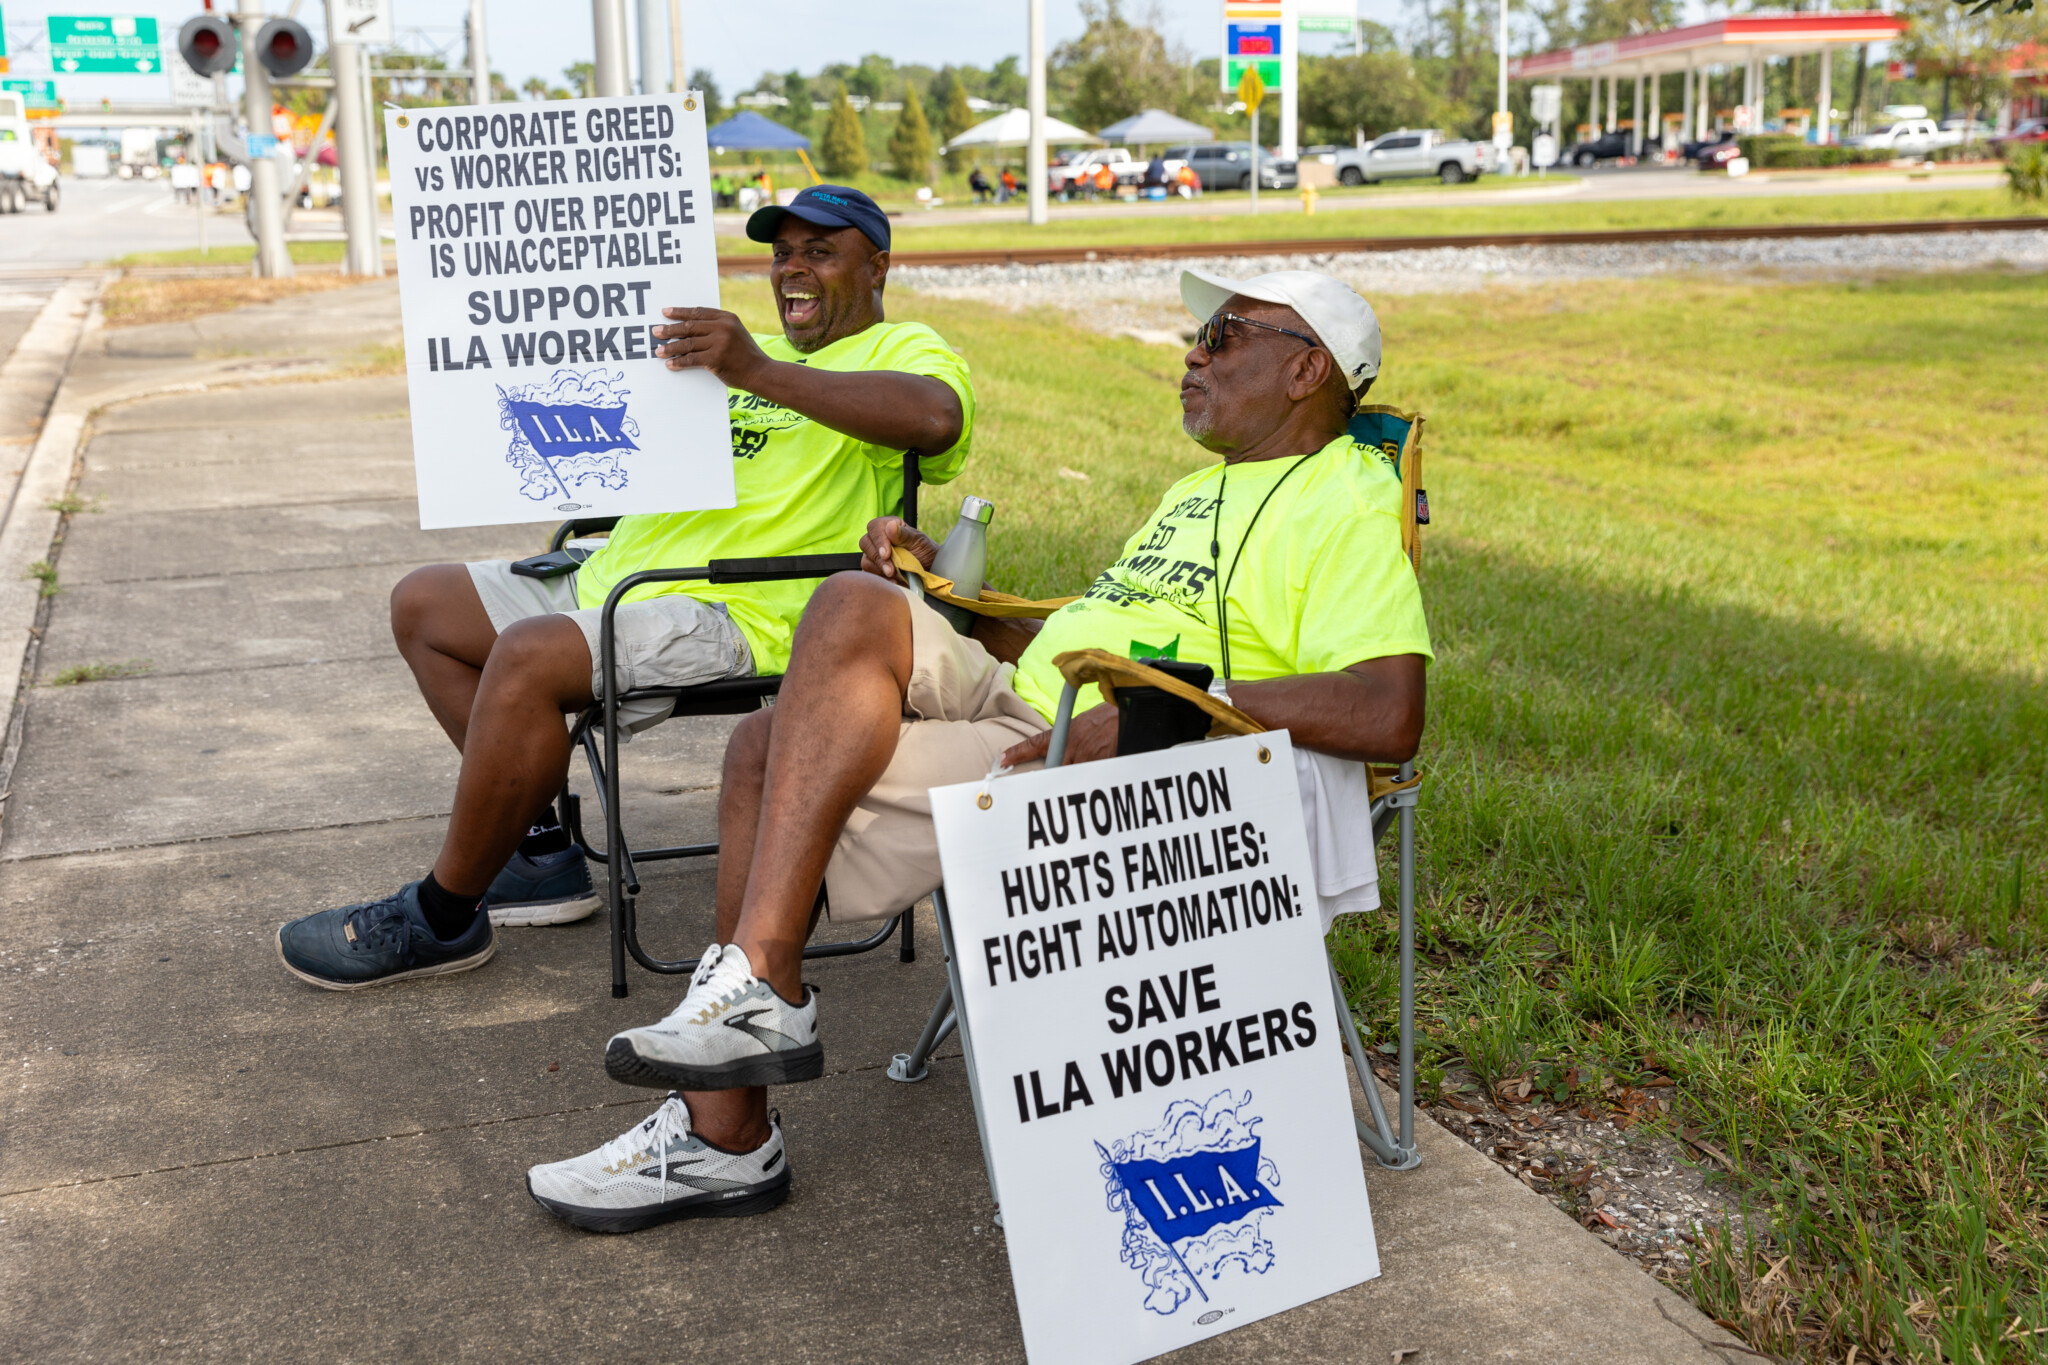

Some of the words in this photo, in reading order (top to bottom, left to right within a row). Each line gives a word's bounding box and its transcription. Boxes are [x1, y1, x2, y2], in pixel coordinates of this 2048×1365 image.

[418, 111, 577, 152] CORPORATE
[587, 105, 673, 143] GREED
[415, 166, 443, 191] vs
[451, 151, 568, 189] WORKER
[576, 144, 681, 182] RIGHTS:
[410, 202, 504, 239] PROFIT
[515, 197, 586, 234] OVER
[594, 190, 695, 229] PEOPLE
[431, 244, 455, 277] IS
[464, 231, 681, 276] UNACCEPTABLE:
[468, 281, 650, 325] SUPPORT
[428, 336, 492, 371] ILA
[502, 325, 668, 367] WORKE
[530, 414, 624, 443] I.L.A.
[1029, 767, 1231, 849] AUTOMATION
[1001, 851, 1114, 917] HURTS
[1122, 822, 1268, 892] FAMILIES:
[984, 920, 1081, 986] FIGHT
[1099, 875, 1301, 962] AUTOMATION:
[1106, 964, 1220, 1033] SAVE
[1014, 1061, 1094, 1123] ILA
[1101, 1002, 1316, 1098] WORKERS
[722, 1190, 748, 1200] REVEL
[1145, 1165, 1260, 1221] I.L.A.
